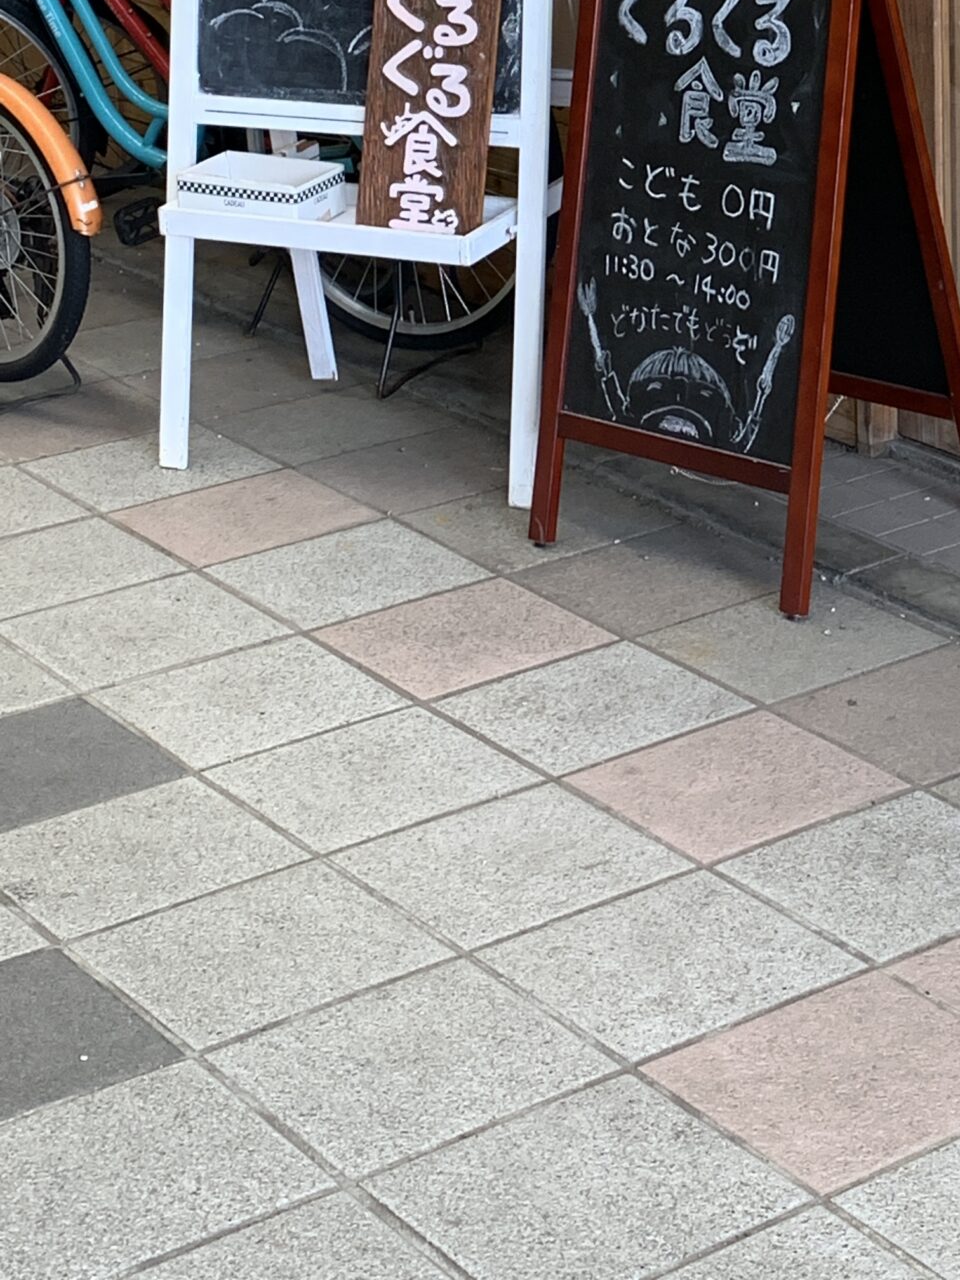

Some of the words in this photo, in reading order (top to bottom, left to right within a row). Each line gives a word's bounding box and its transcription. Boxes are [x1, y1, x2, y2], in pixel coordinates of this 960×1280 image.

[674, 56, 778, 166] 食堂
[619, 157, 702, 212] こども
[722, 184, 775, 231] 0円
